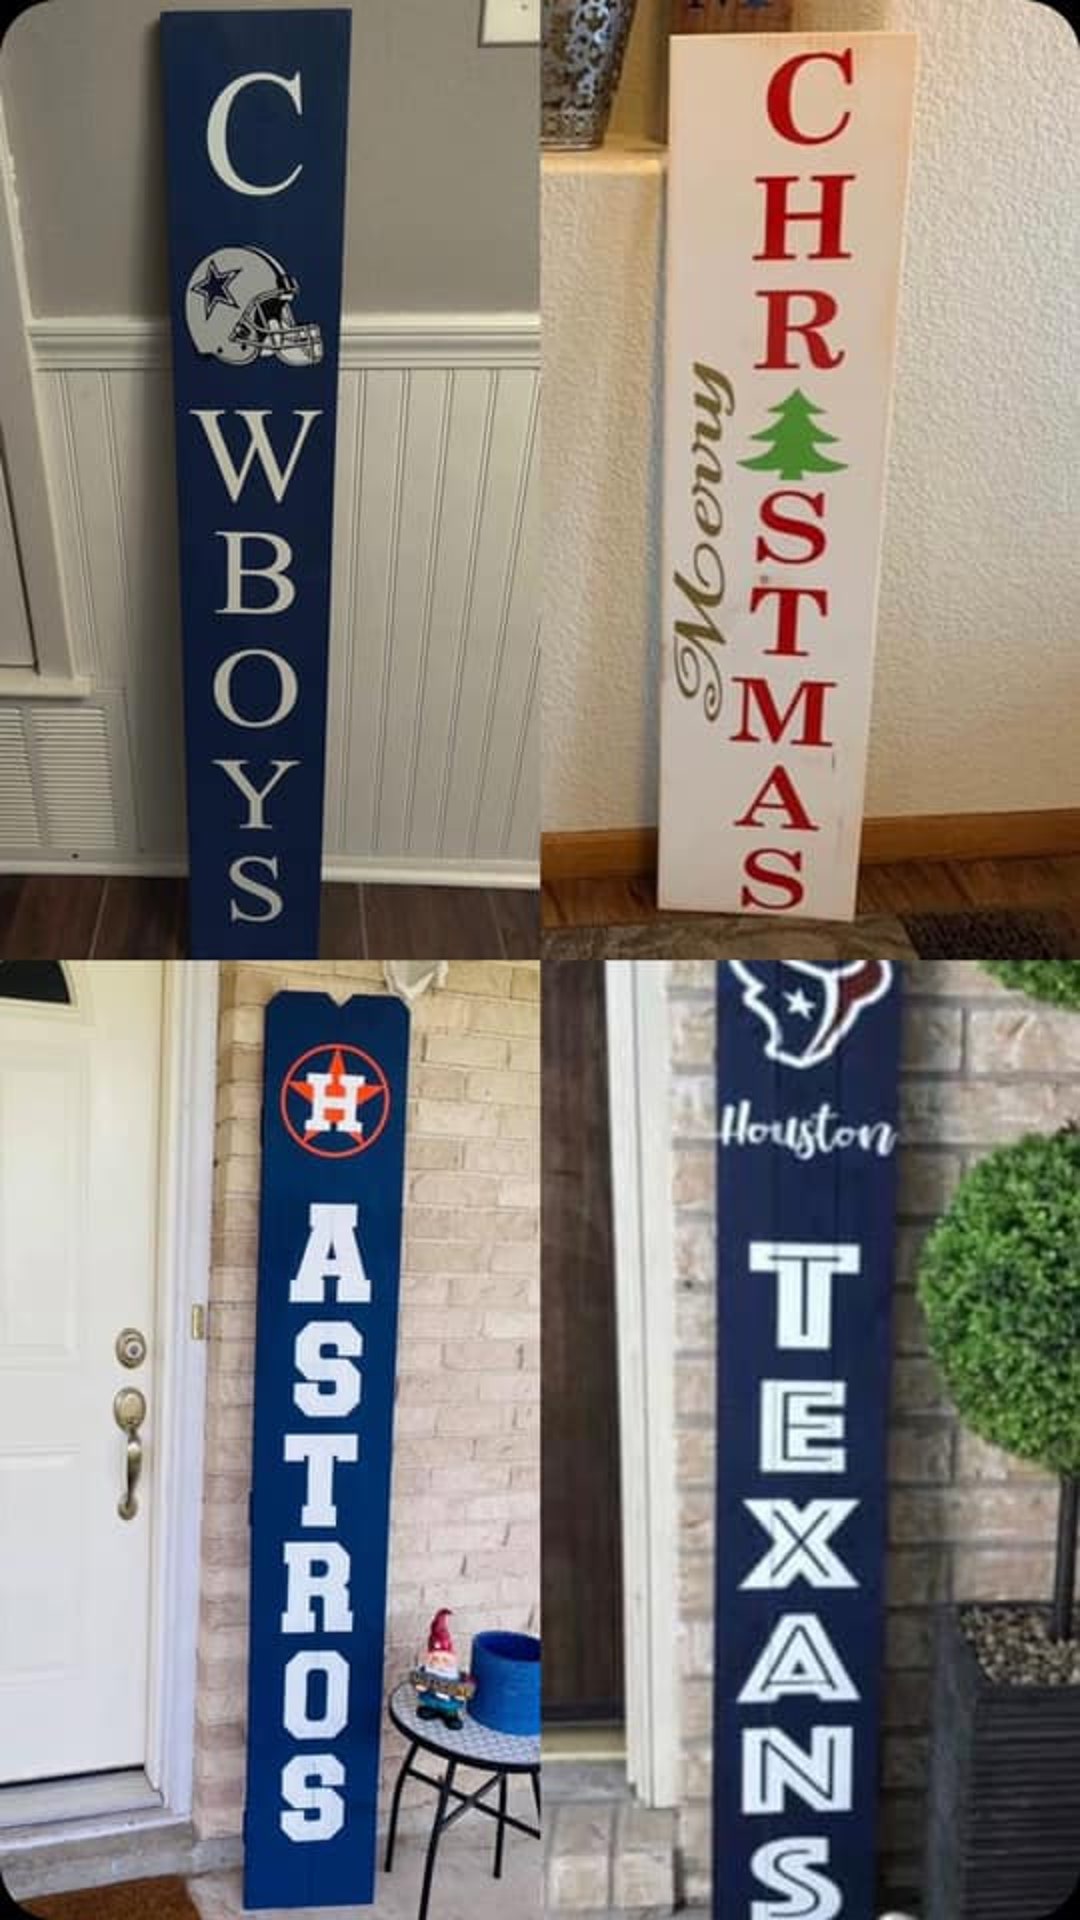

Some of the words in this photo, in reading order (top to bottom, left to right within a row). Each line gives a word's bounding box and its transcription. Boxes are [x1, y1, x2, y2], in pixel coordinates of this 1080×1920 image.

[188, 70, 324, 924] CWBOYS
[672, 361, 737, 722] Merry
[728, 47, 857, 911] CHRSTMAS
[304, 1072, 367, 1133] H
[718, 1100, 898, 1160] Houston
[279, 1202, 372, 1843] ASTROS
[736, 1240, 862, 1920] TEXANS
